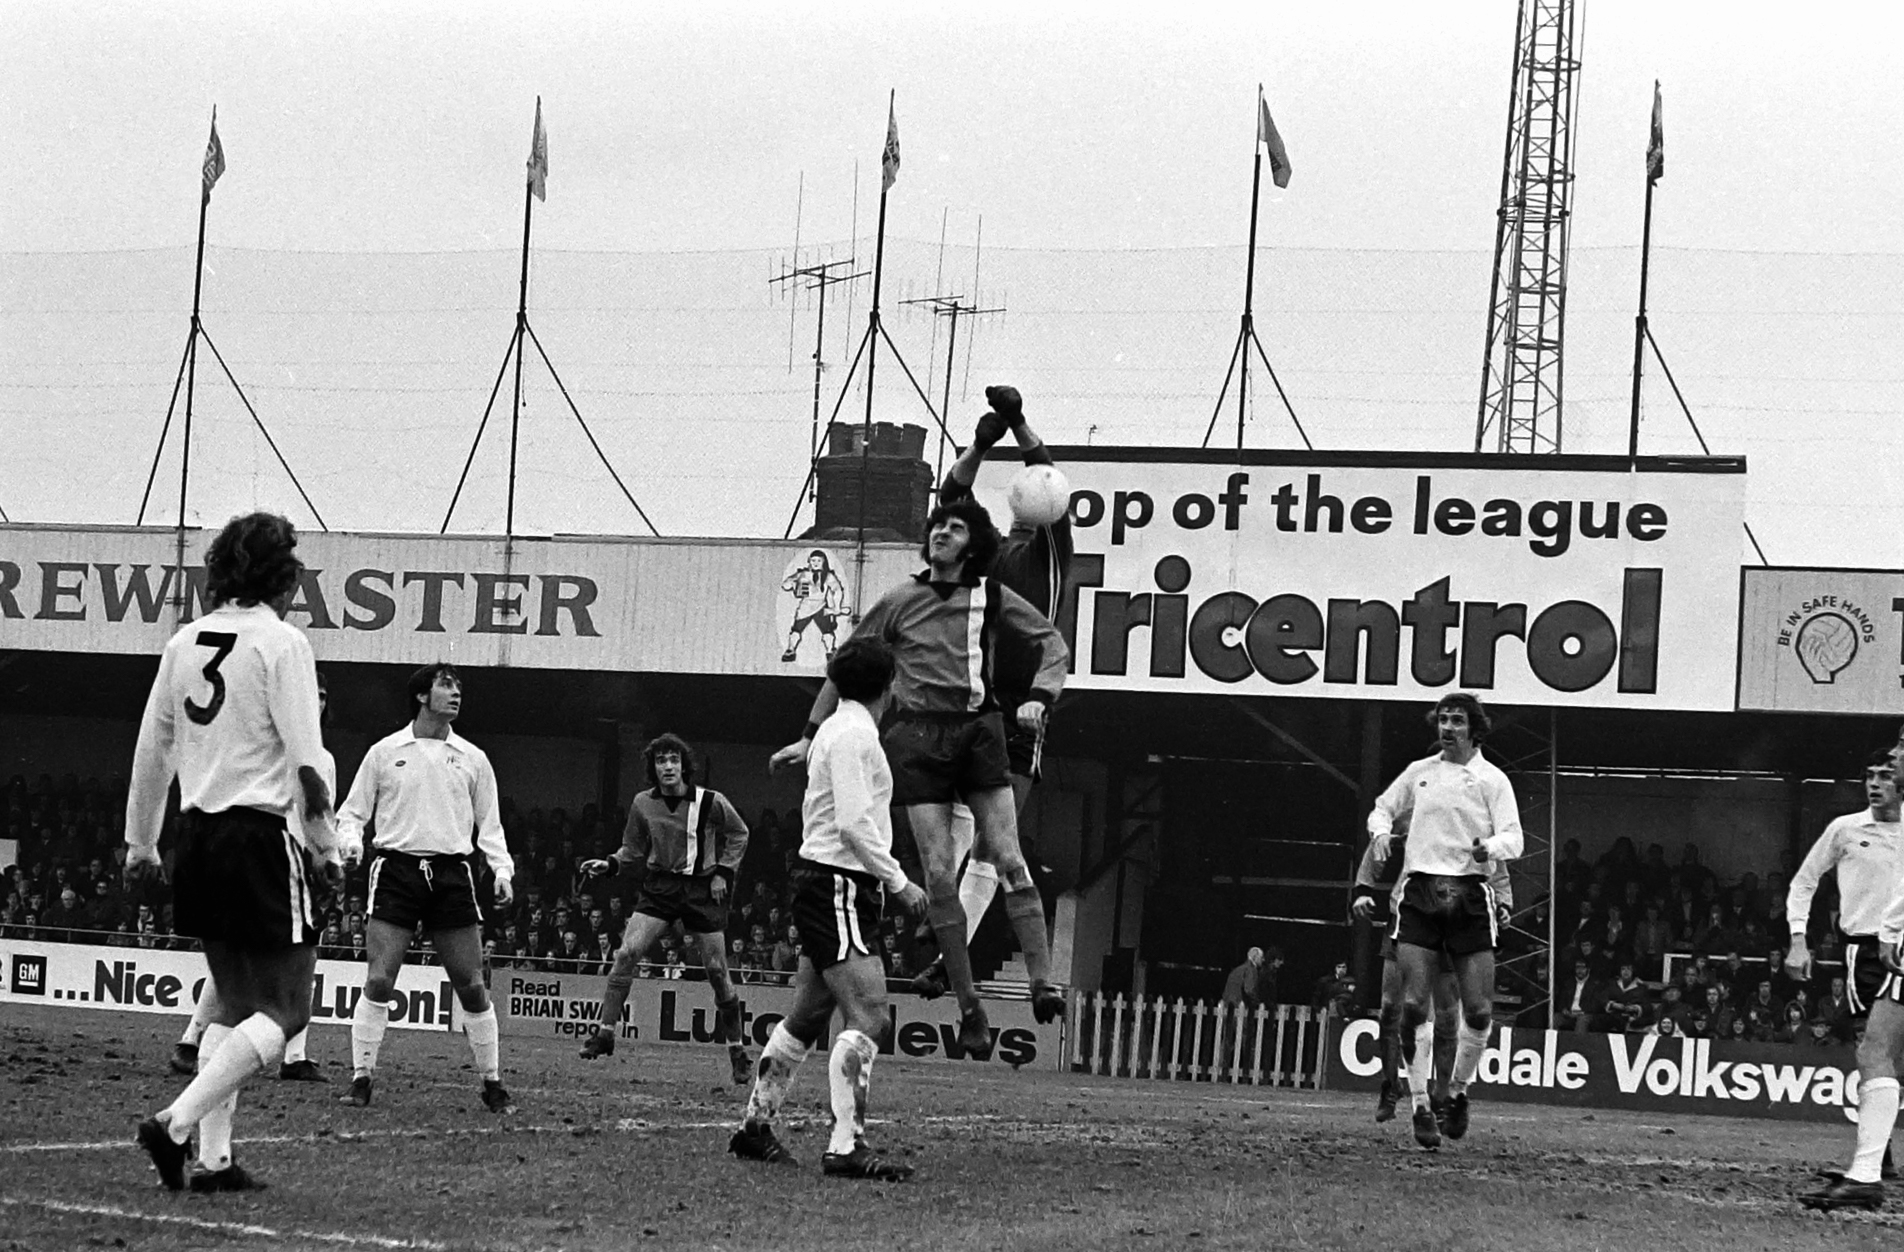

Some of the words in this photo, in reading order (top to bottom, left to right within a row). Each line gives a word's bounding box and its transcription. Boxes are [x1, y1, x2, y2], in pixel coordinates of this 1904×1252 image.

[1069, 489, 1155, 546] op
[1172, 472, 1249, 531] of
[1271, 473, 1393, 534] the
[1412, 475, 1668, 558] league
[1777, 629, 1793, 647] BE
[1786, 611, 1802, 627] IN
[1802, 595, 1838, 614] SAFE
[1840, 600, 1875, 644] HANDS
[184, 631, 239, 726] 3
[19, 963, 40, 982] GM
[510, 977, 561, 997] Read
[311, 973, 451, 1025] Luon!
[510, 996, 564, 1019] BRIAN
[621, 1021, 639, 1040] in
